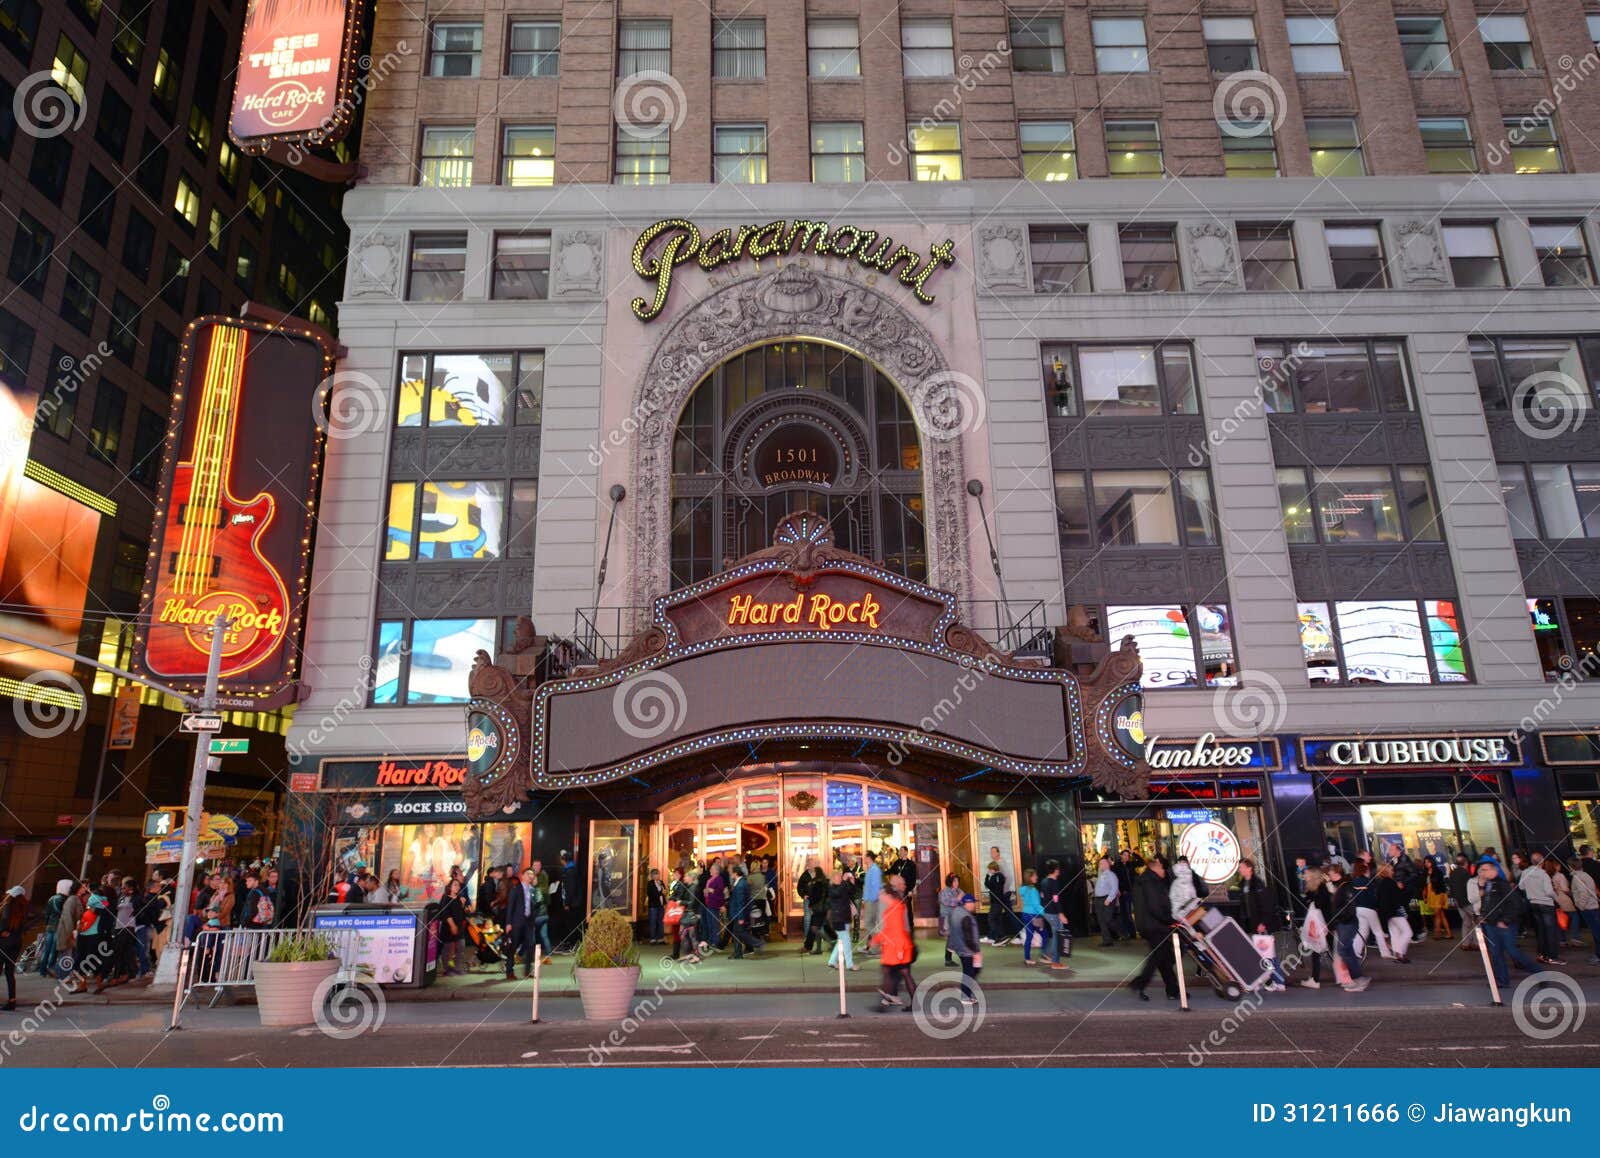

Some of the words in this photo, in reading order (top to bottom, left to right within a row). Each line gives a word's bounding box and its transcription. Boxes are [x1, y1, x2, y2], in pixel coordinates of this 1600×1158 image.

[273, 33, 319, 51] SEE
[249, 49, 295, 68] THE
[268, 58, 331, 80] SHOW
[241, 90, 284, 112] Hard
[286, 85, 326, 110] Rock
[271, 109, 295, 119] CAFE
[631, 217, 956, 323] Paramount
[776, 448, 817, 463] 1501
[765, 468, 830, 484] BROADWAY
[159, 598, 225, 623] Hard
[226, 603, 283, 636] Rock
[727, 592, 804, 626] Hard
[808, 592, 881, 631] Rock
[220, 741, 228, 751] 7
[1329, 737, 1509, 766] CLUBHOUSE
[376, 760, 433, 786] Hard
[431, 760, 468, 789] Roc
[393, 802, 432, 815] ROCK
[320, 918, 337, 927] Keep
[338, 918, 353, 926] NYC
[391, 917, 412, 925] Clean!
